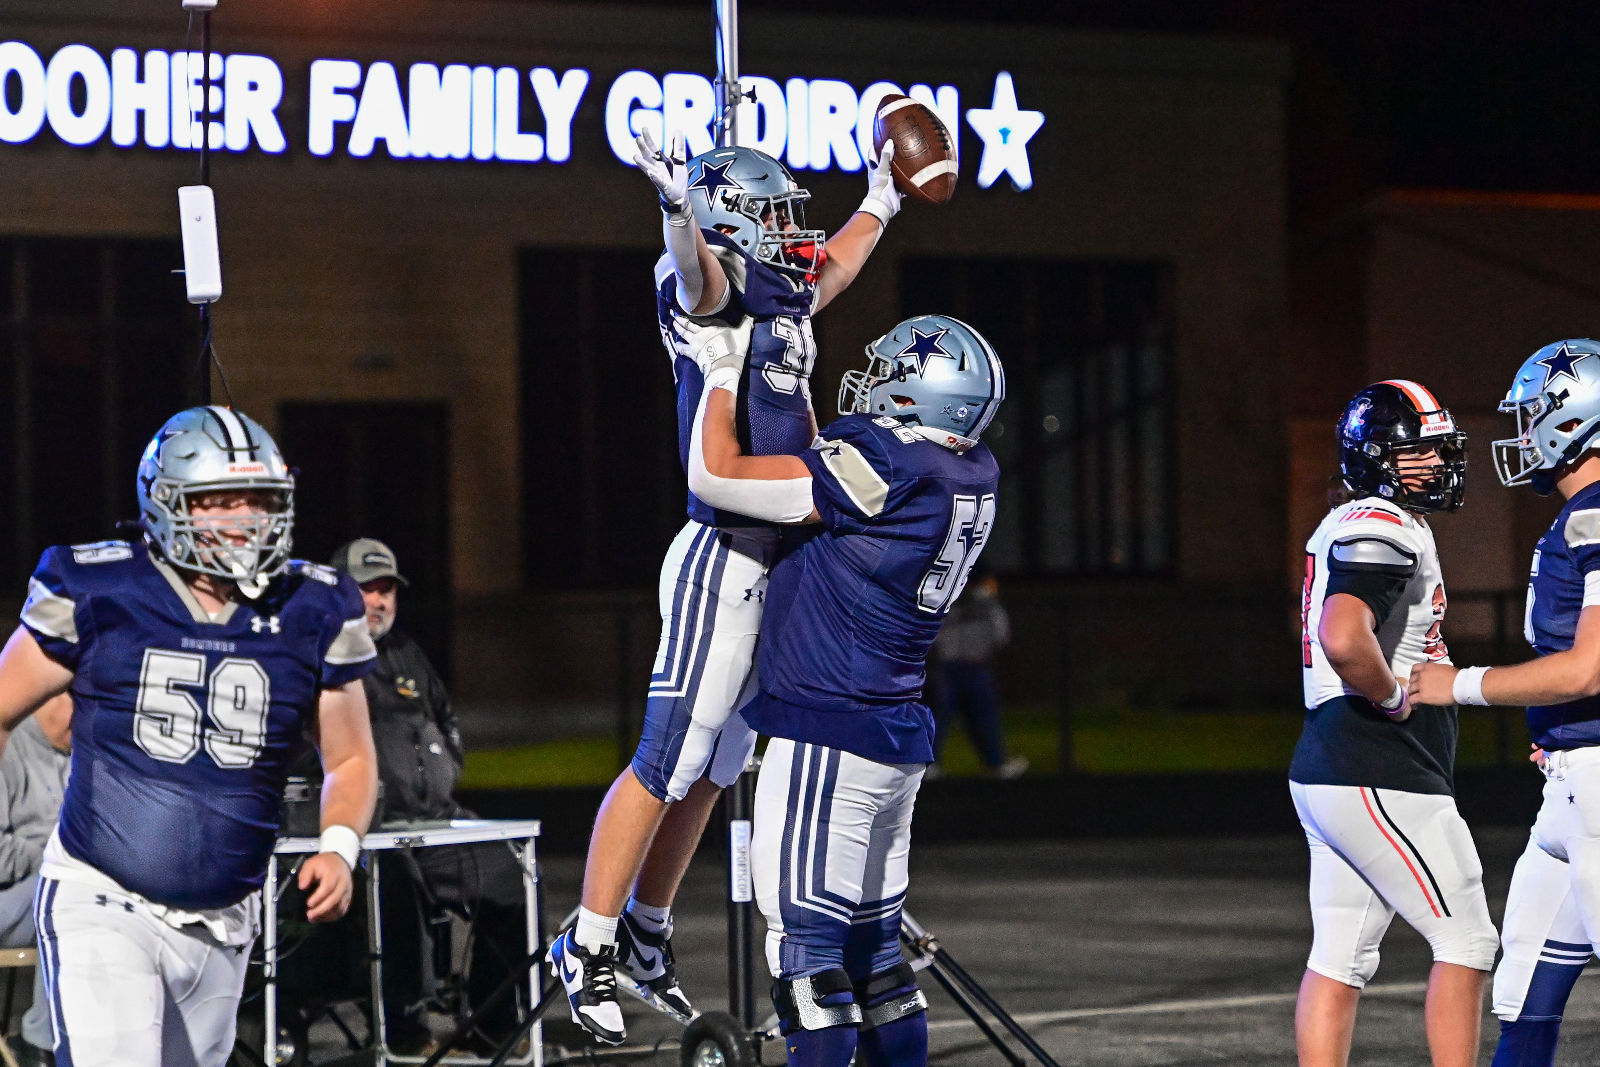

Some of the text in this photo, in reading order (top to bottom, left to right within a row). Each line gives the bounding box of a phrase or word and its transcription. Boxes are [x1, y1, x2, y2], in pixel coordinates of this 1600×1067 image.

[308, 59, 590, 164] FAMILY
[917, 493, 996, 614] 52
[133, 647, 270, 770] 59
